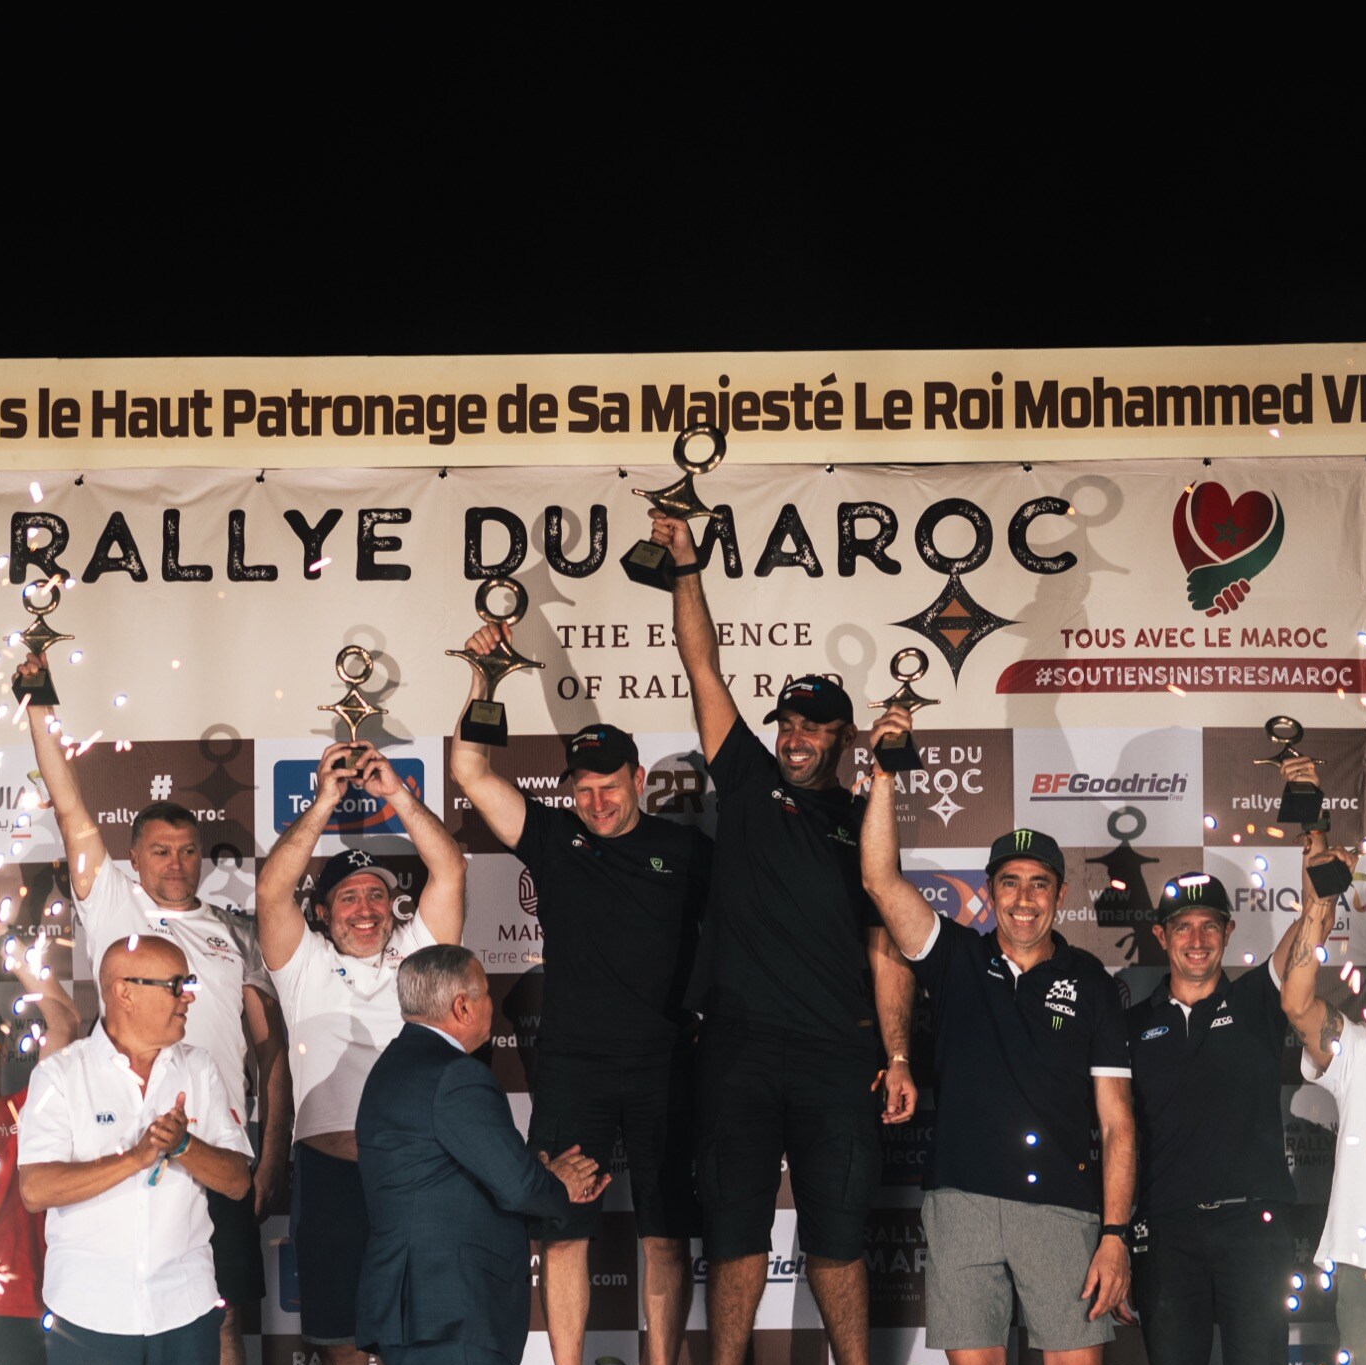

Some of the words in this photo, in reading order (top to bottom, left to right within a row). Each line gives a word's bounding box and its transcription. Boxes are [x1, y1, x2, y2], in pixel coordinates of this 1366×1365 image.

[38, 387, 81, 439] le
[91, 389, 213, 439] Haut
[223, 388, 488, 446] Patronage
[497, 383, 559, 434] de
[567, 384, 630, 434] Sa
[641, 372, 844, 446] Majesté
[854, 382, 913, 431] Le
[923, 371, 1004, 430] Roi
[1014, 372, 1314, 430] Mohammed
[10, 508, 412, 584] RALLYE
[464, 504, 608, 581] DU
[557, 624, 630, 648] THE
[647, 622, 813, 647] EENCE
[1059, 628, 1127, 649] TOUS
[1134, 627, 1194, 648] AVEC
[1199, 627, 1232, 648] LE
[1240, 626, 1329, 649] MAROC
[1034, 664, 1353, 689] #SOUTIENSINISTRESMAROC
[557, 676, 602, 700] OF
[950, 746, 982, 763] DU
[516, 775, 559, 789] www
[1032, 773, 1187, 794] BFGoodrich
[288, 794, 377, 814] Tecom
[1232, 795, 1359, 811] rallyearoc
[480, 949, 517, 964] Terre
[96, 1113, 115, 1123] FIA
